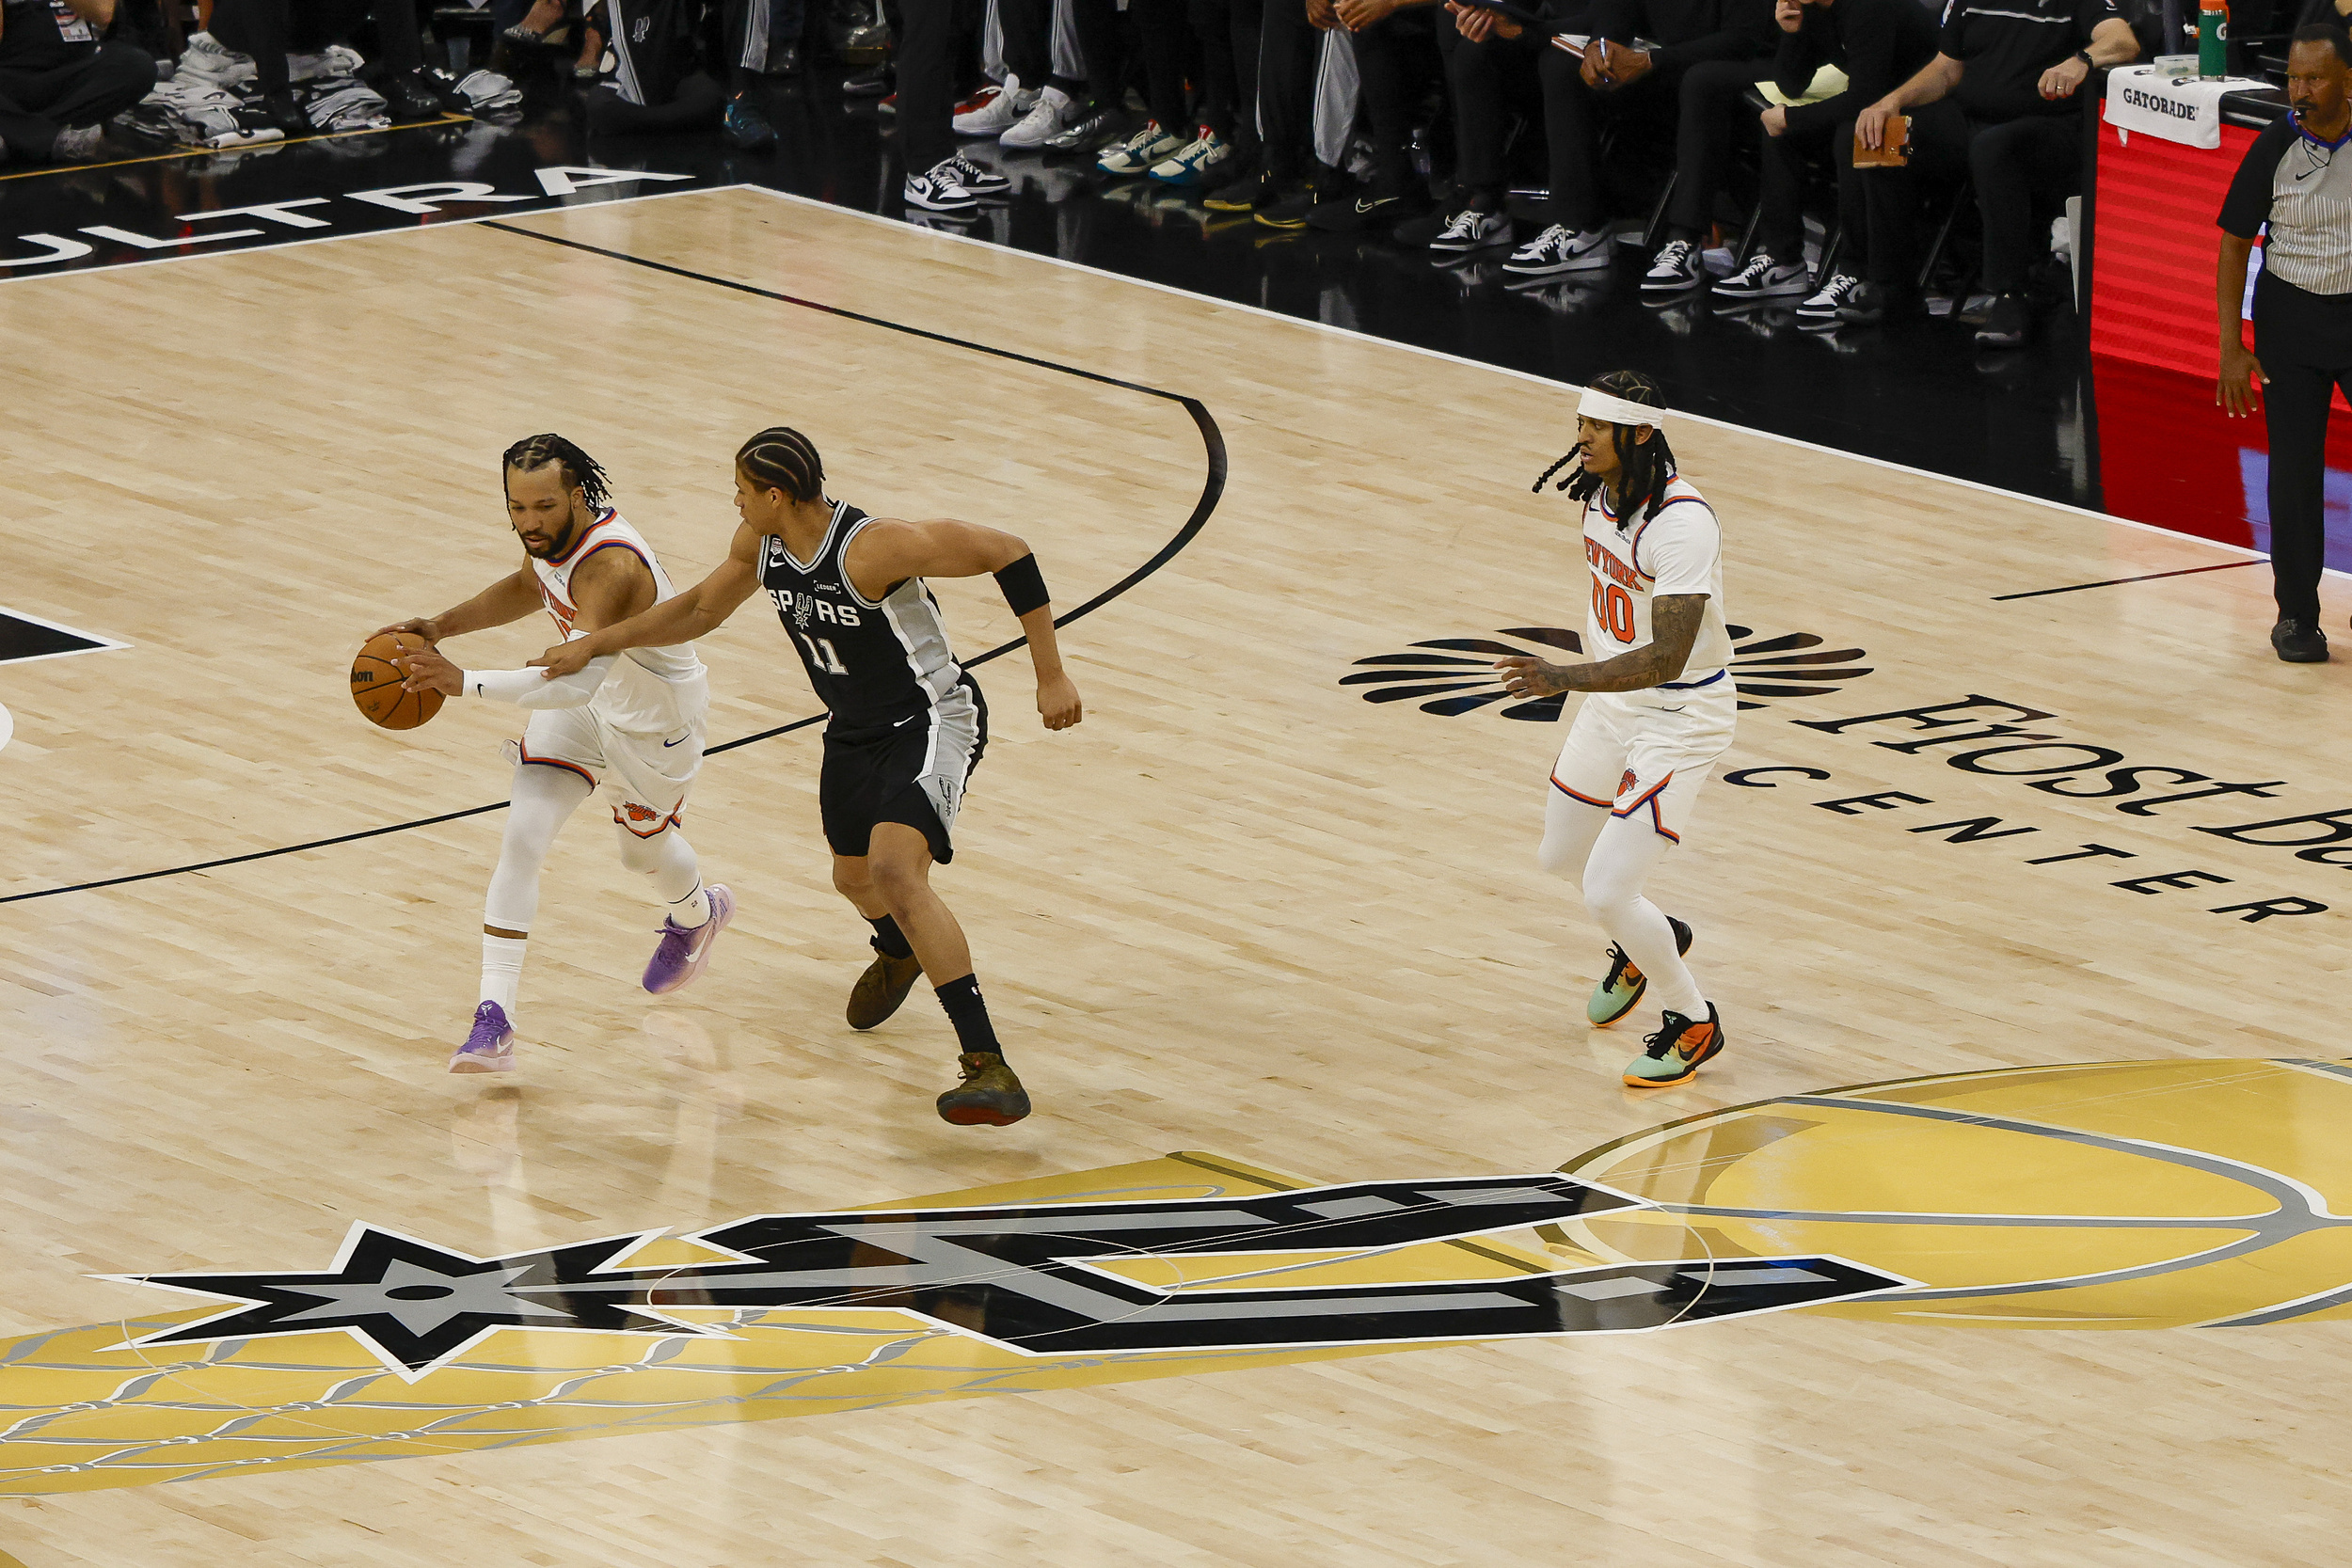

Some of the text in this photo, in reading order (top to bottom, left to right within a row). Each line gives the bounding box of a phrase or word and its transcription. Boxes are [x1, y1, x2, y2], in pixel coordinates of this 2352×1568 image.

[2123, 87, 2196, 120] GATORADE
[1601, 546, 1645, 592] YORK
[1591, 571, 1635, 644] 00
[799, 631, 850, 675] 11
[1724, 766, 2328, 924] CENTER
